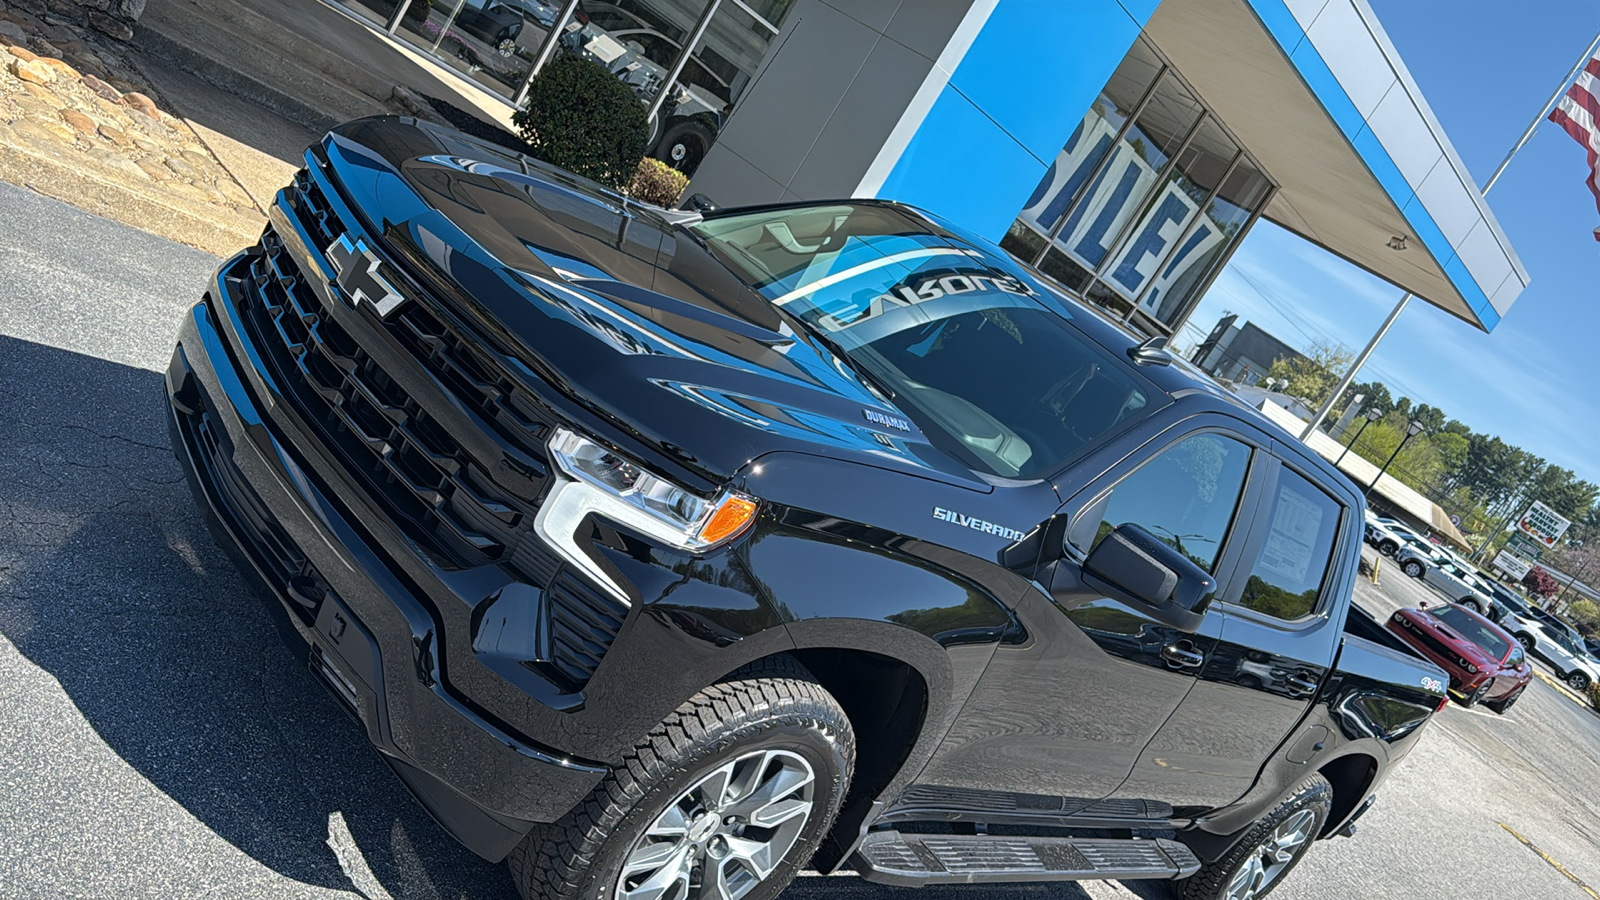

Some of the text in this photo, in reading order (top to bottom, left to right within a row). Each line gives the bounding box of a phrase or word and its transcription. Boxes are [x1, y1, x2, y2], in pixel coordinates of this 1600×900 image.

[863, 409, 911, 432] DURAMAX
[933, 506, 1025, 542] SILVERADO
[1529, 513, 1559, 534] HARVEST
[1530, 506, 1559, 526] HEALTHY
[1528, 519, 1558, 541] PRODUCE
